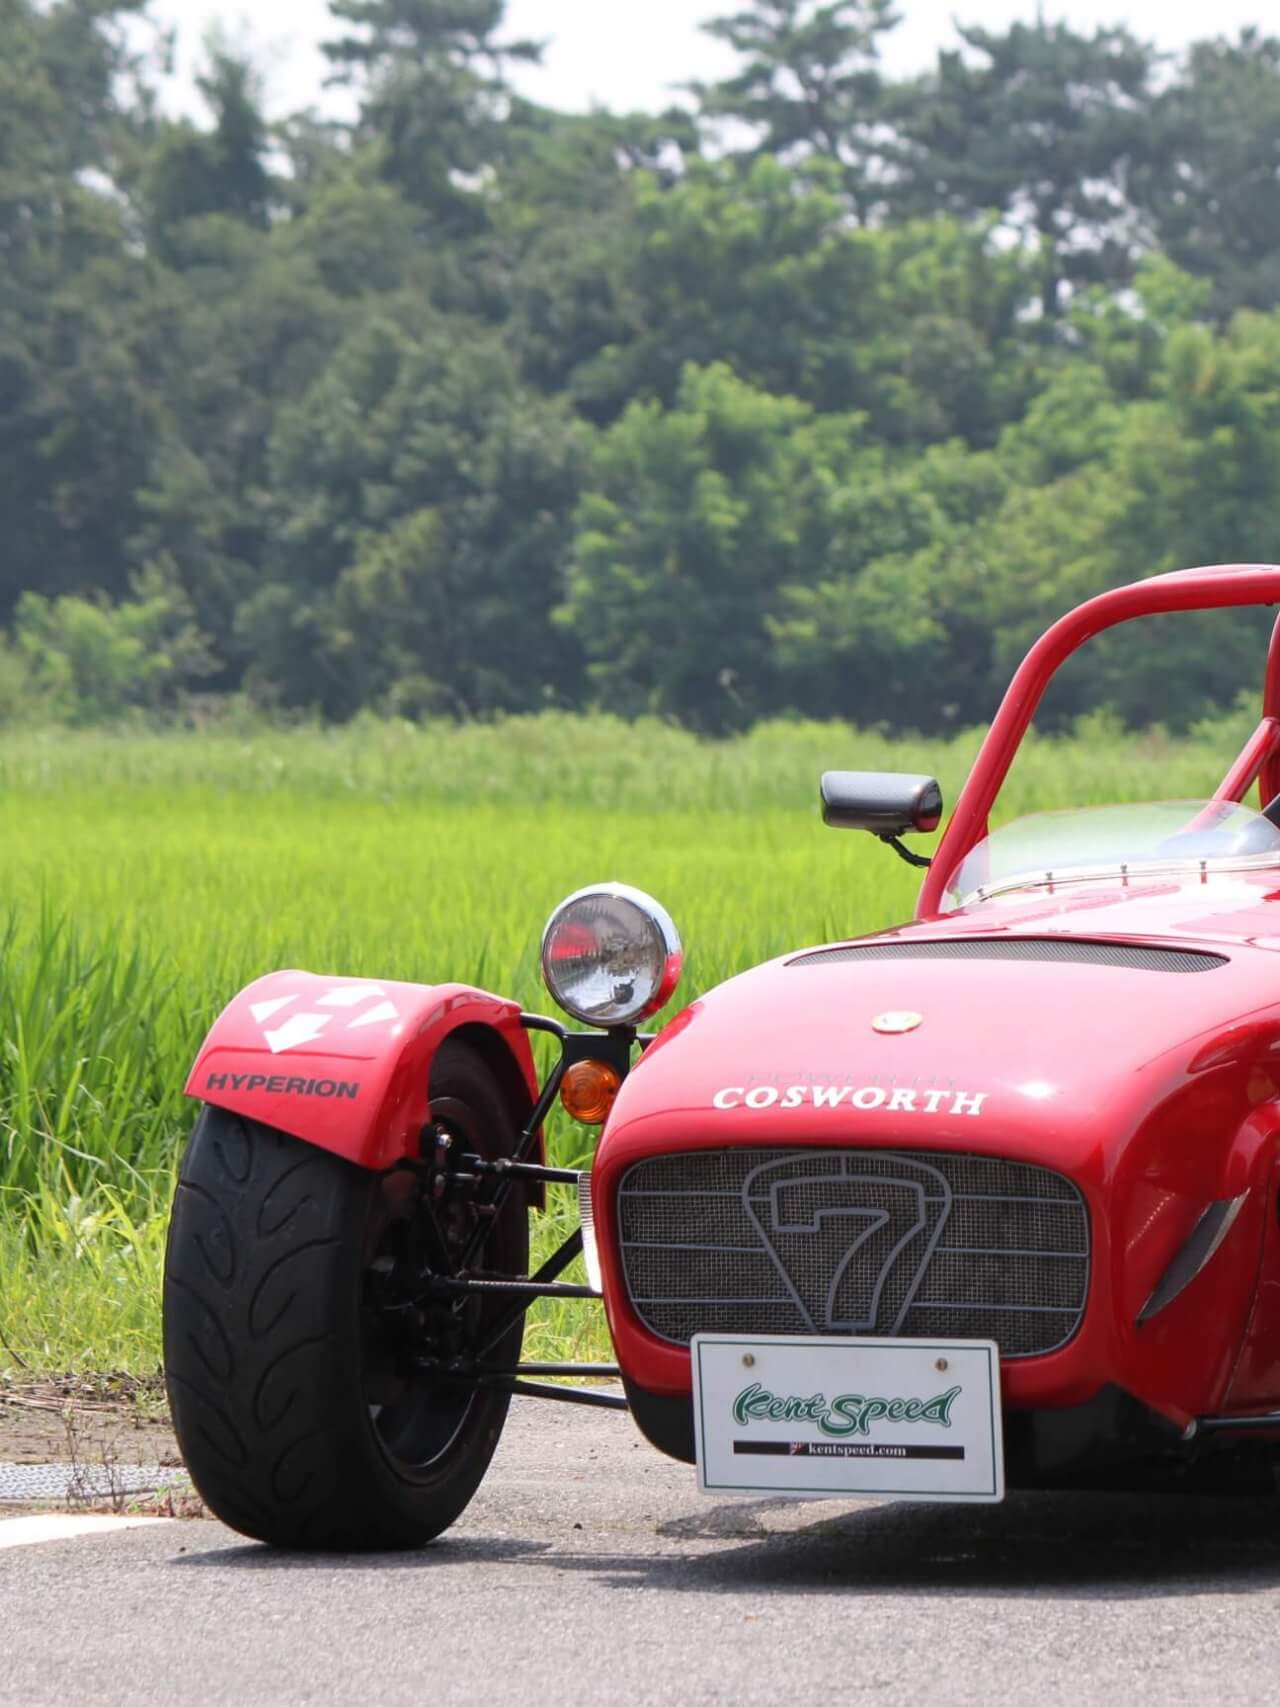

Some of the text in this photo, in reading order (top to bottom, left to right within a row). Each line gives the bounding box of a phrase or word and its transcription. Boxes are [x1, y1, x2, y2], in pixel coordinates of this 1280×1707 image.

[206, 1073, 359, 1098] HYPERION
[713, 1086, 988, 1115] COSWORTH
[770, 1175, 926, 1329] 7
[808, 1441, 906, 1457] kentspeed.com
